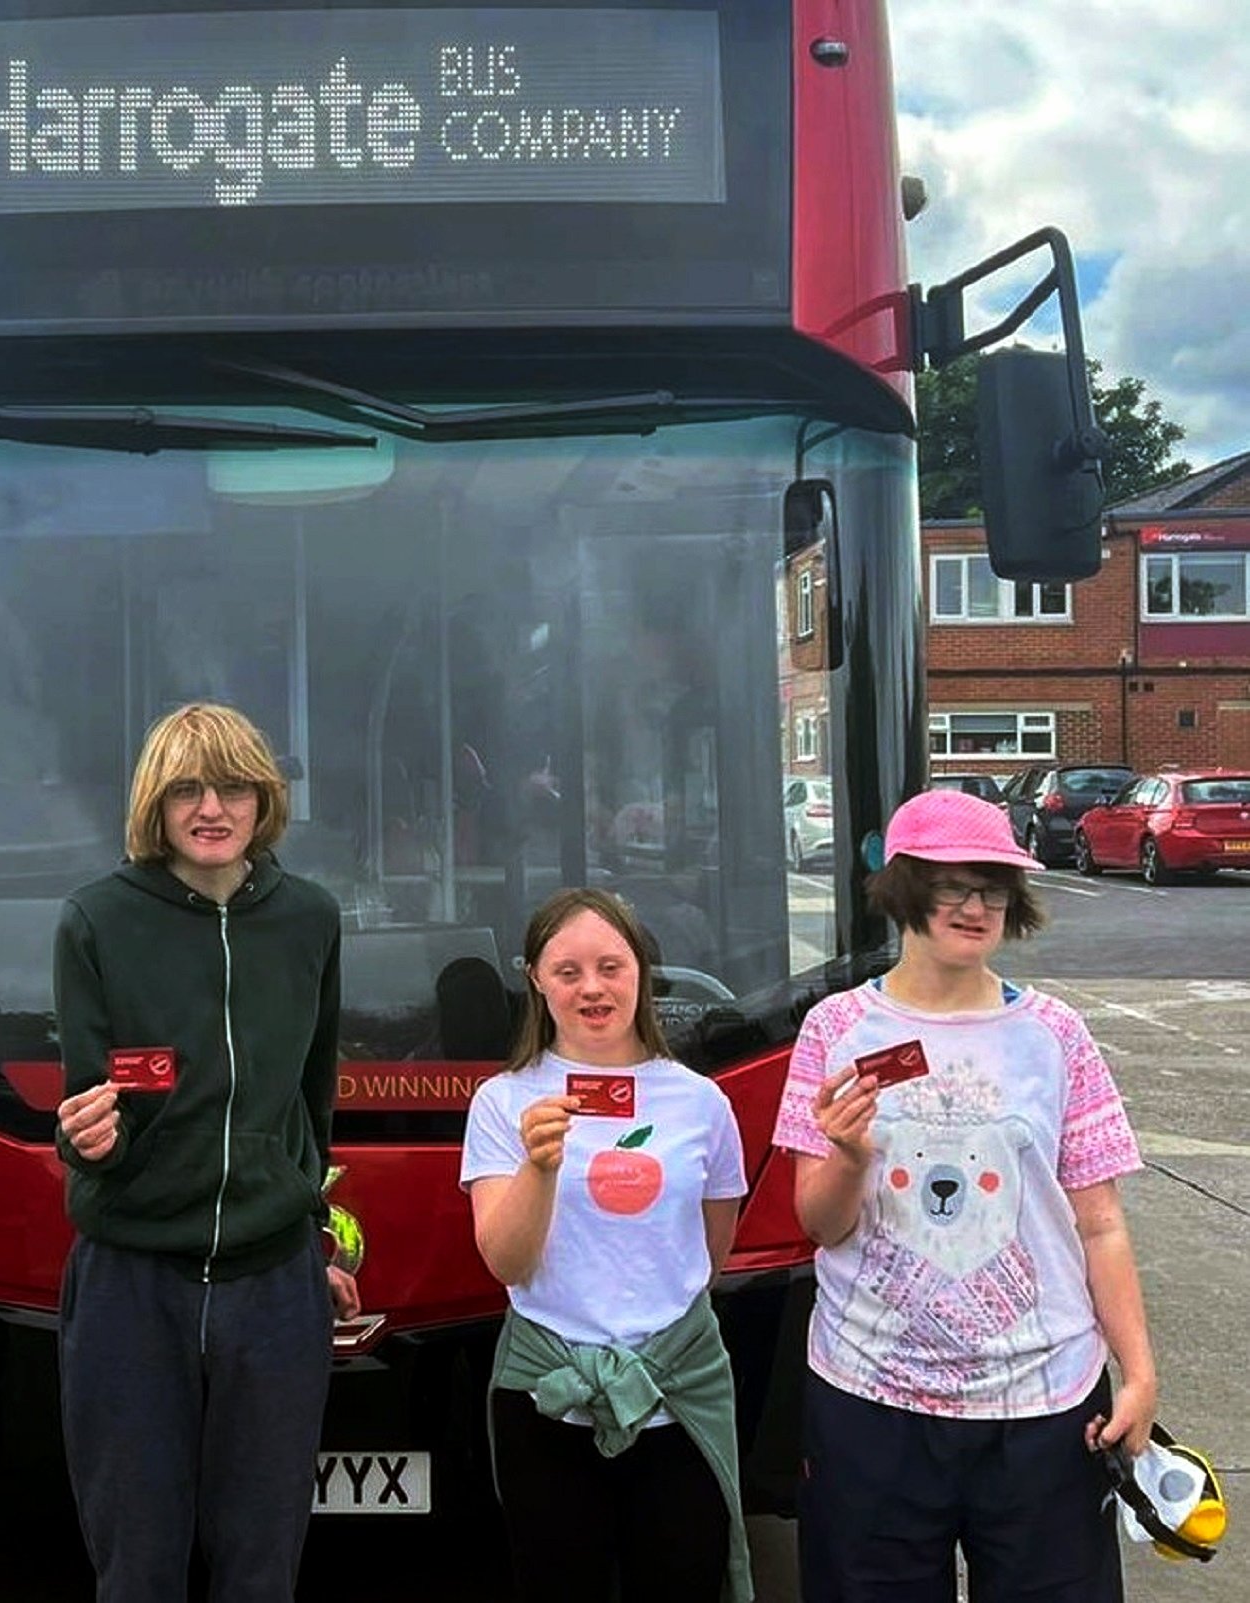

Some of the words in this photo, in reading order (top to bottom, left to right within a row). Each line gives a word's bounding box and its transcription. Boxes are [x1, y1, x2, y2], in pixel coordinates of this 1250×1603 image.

[440, 46, 521, 96] BUS
[441, 107, 681, 158] COMPANY
[315, 1456, 409, 1504] YYX
